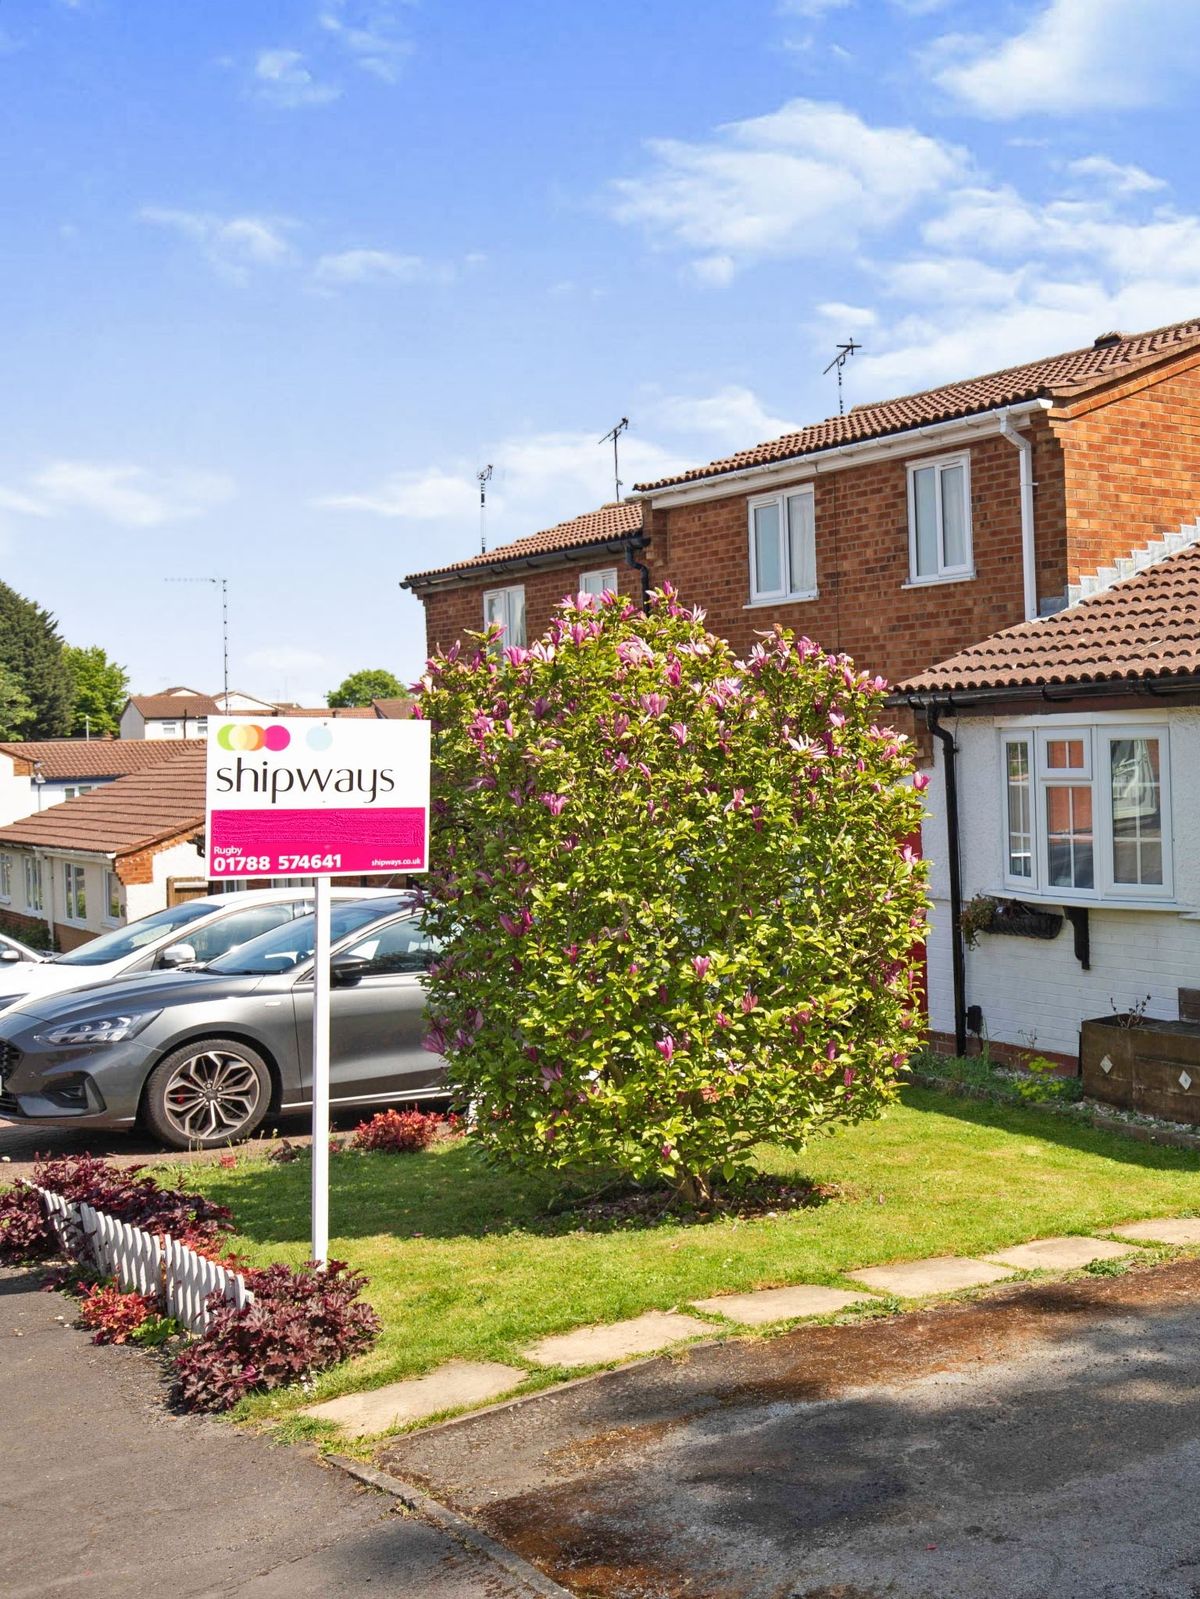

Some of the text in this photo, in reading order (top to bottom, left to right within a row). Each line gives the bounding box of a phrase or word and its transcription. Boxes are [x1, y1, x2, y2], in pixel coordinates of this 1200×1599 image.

[216, 757, 395, 803] shipways
[213, 846, 242, 856] Rugby
[213, 854, 342, 872] 01788 574641
[371, 857, 421, 867] shipways.co.uk
